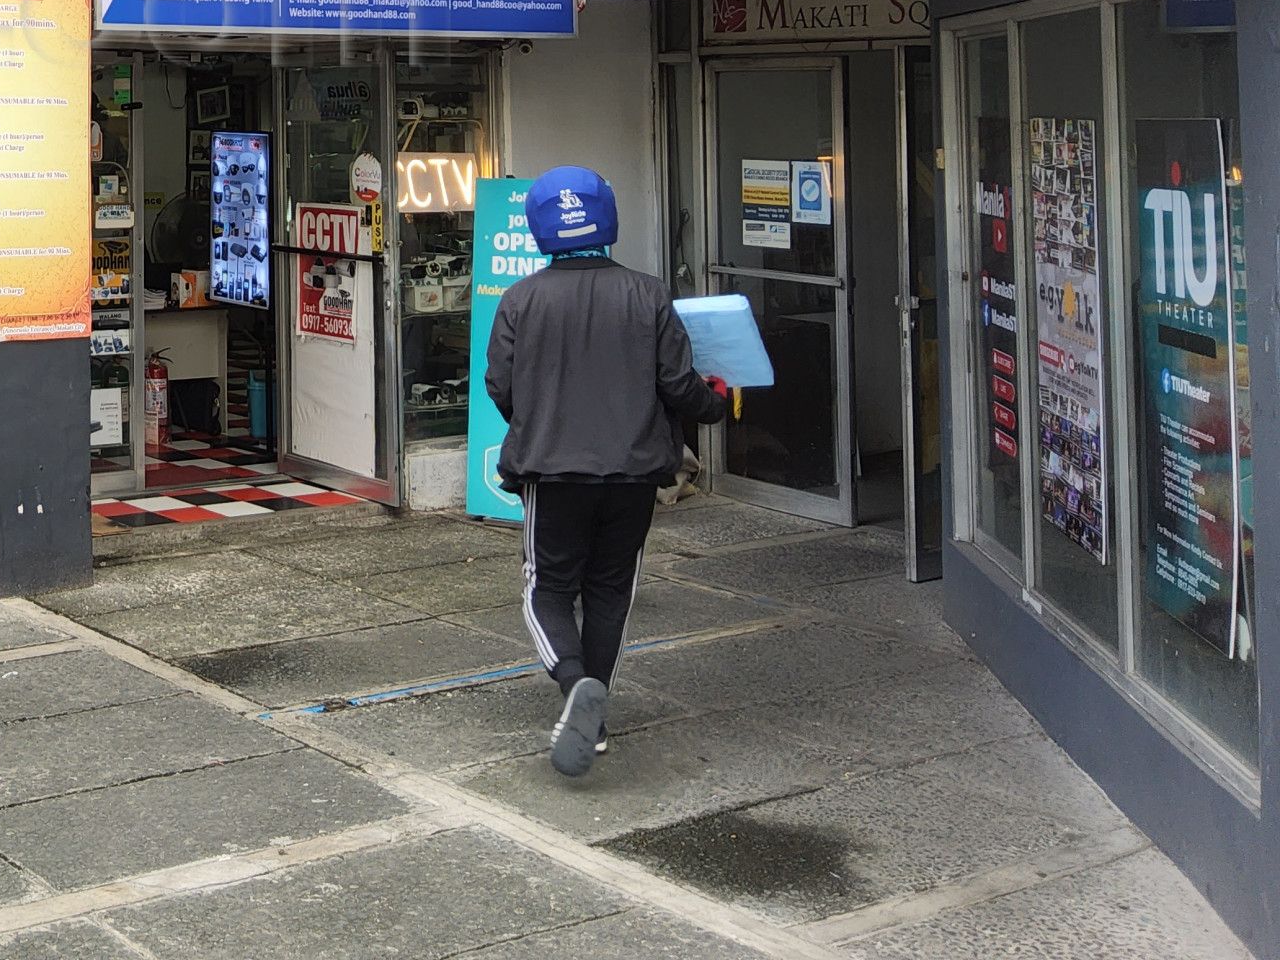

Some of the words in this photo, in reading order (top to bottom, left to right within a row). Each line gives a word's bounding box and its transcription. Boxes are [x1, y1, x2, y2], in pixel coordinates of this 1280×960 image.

[289, 7, 324, 17] Website:
[325, 8, 416, 20] www.goodhand88.com
[302, 211, 357, 254] CCTV
[1157, 299, 1214, 329] THEATER
